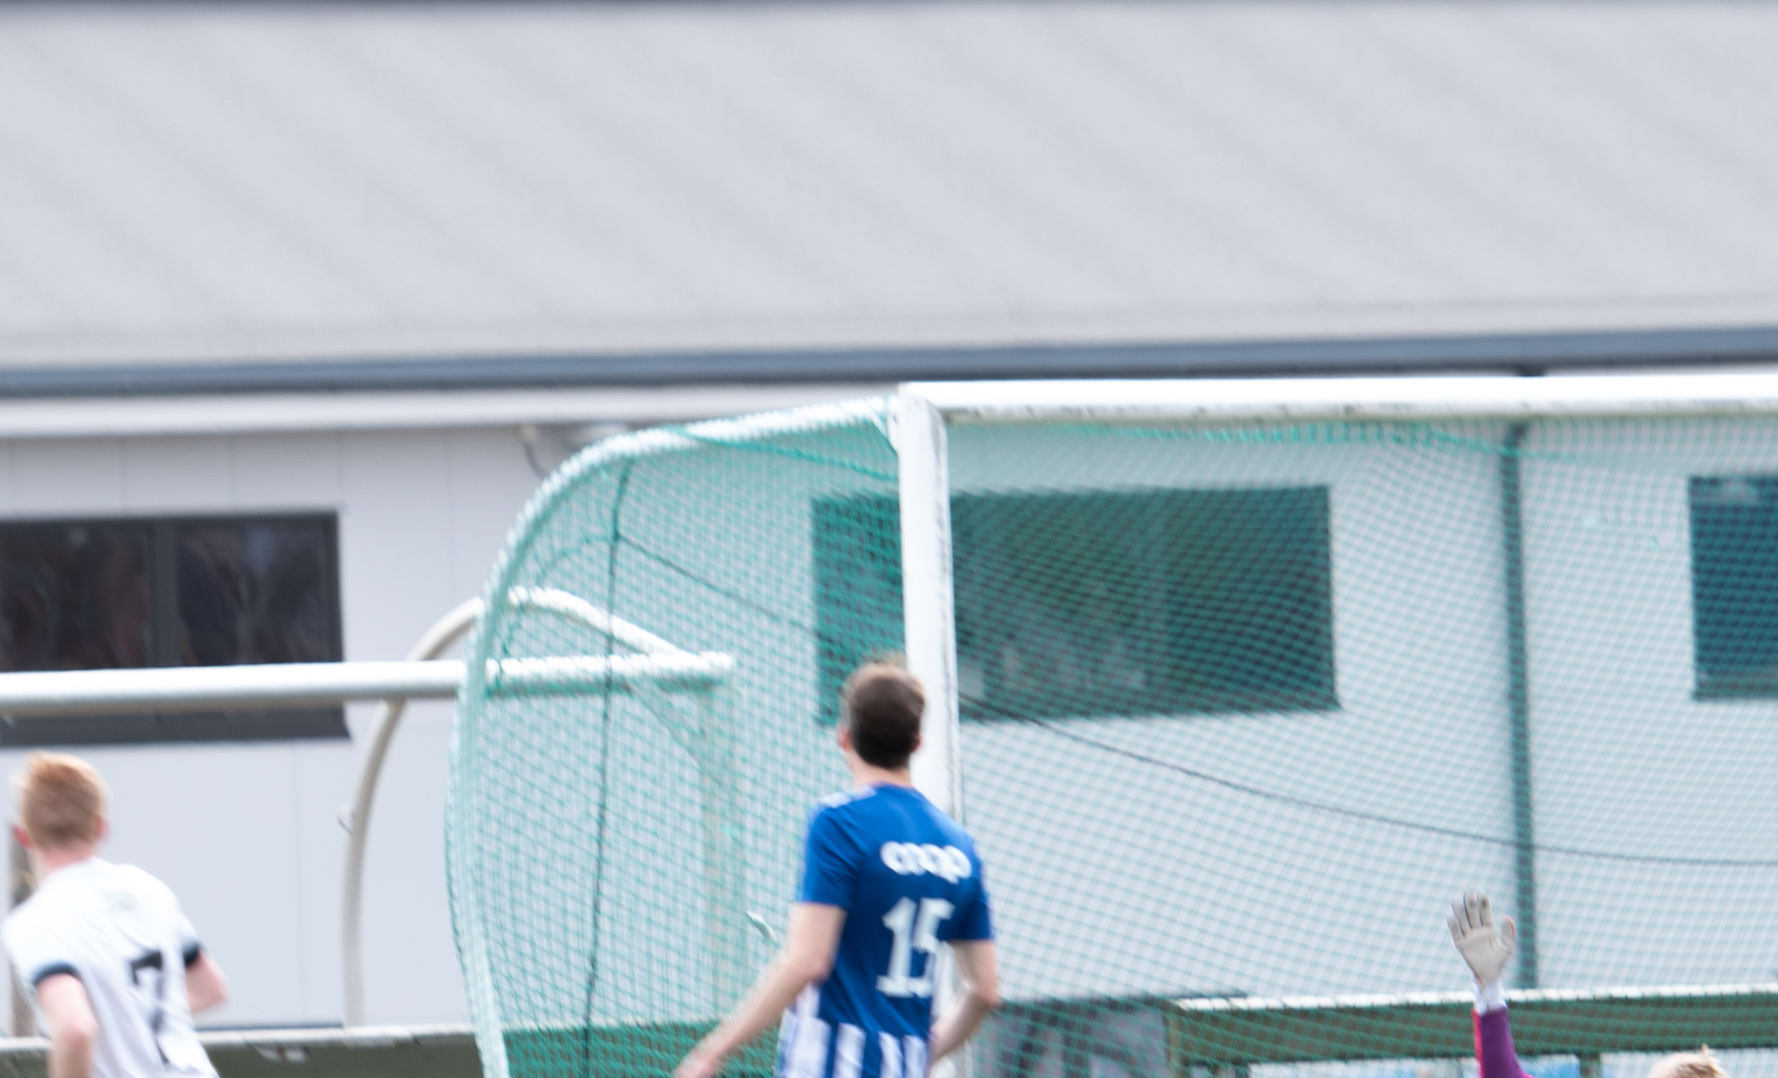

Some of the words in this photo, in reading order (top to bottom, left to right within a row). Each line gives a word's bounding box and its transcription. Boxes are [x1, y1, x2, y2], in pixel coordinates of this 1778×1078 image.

[881, 841, 972, 884] coop
[876, 897, 955, 998] 15
[129, 950, 168, 1066] 7
